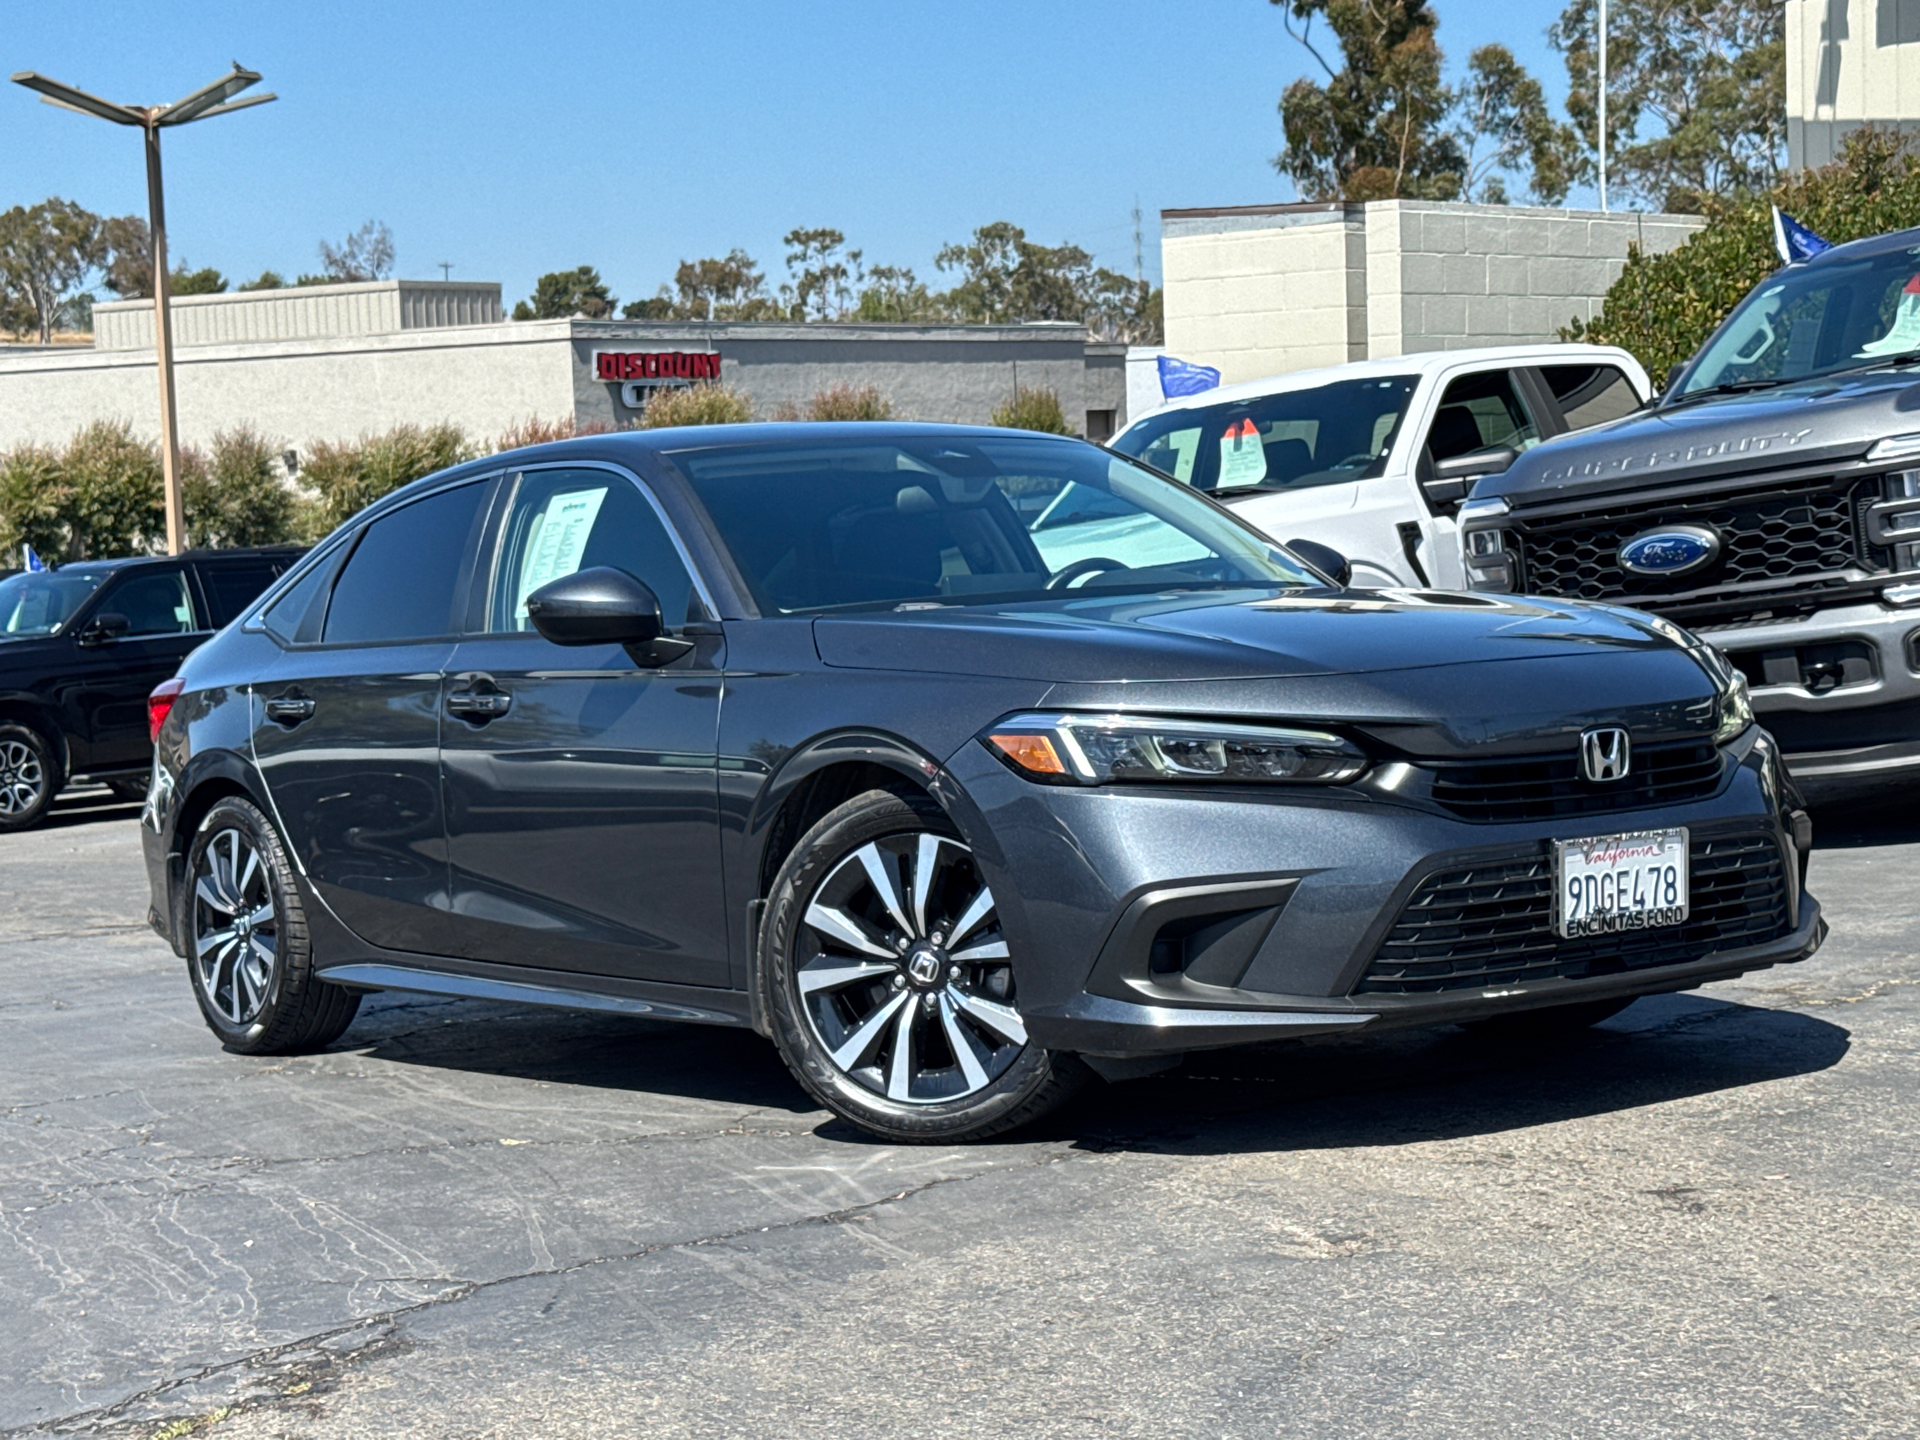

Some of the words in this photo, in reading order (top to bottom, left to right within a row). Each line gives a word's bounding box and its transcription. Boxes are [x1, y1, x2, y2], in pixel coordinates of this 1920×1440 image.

[597, 352, 721, 380] DISCOUNT
[1687, 428, 1813, 461] DUTY
[1585, 843, 1662, 868] California
[1568, 864, 1678, 918] 9DGE478
[1566, 912, 1645, 937] ENCINITAS
[1647, 906, 1684, 926] FORD
